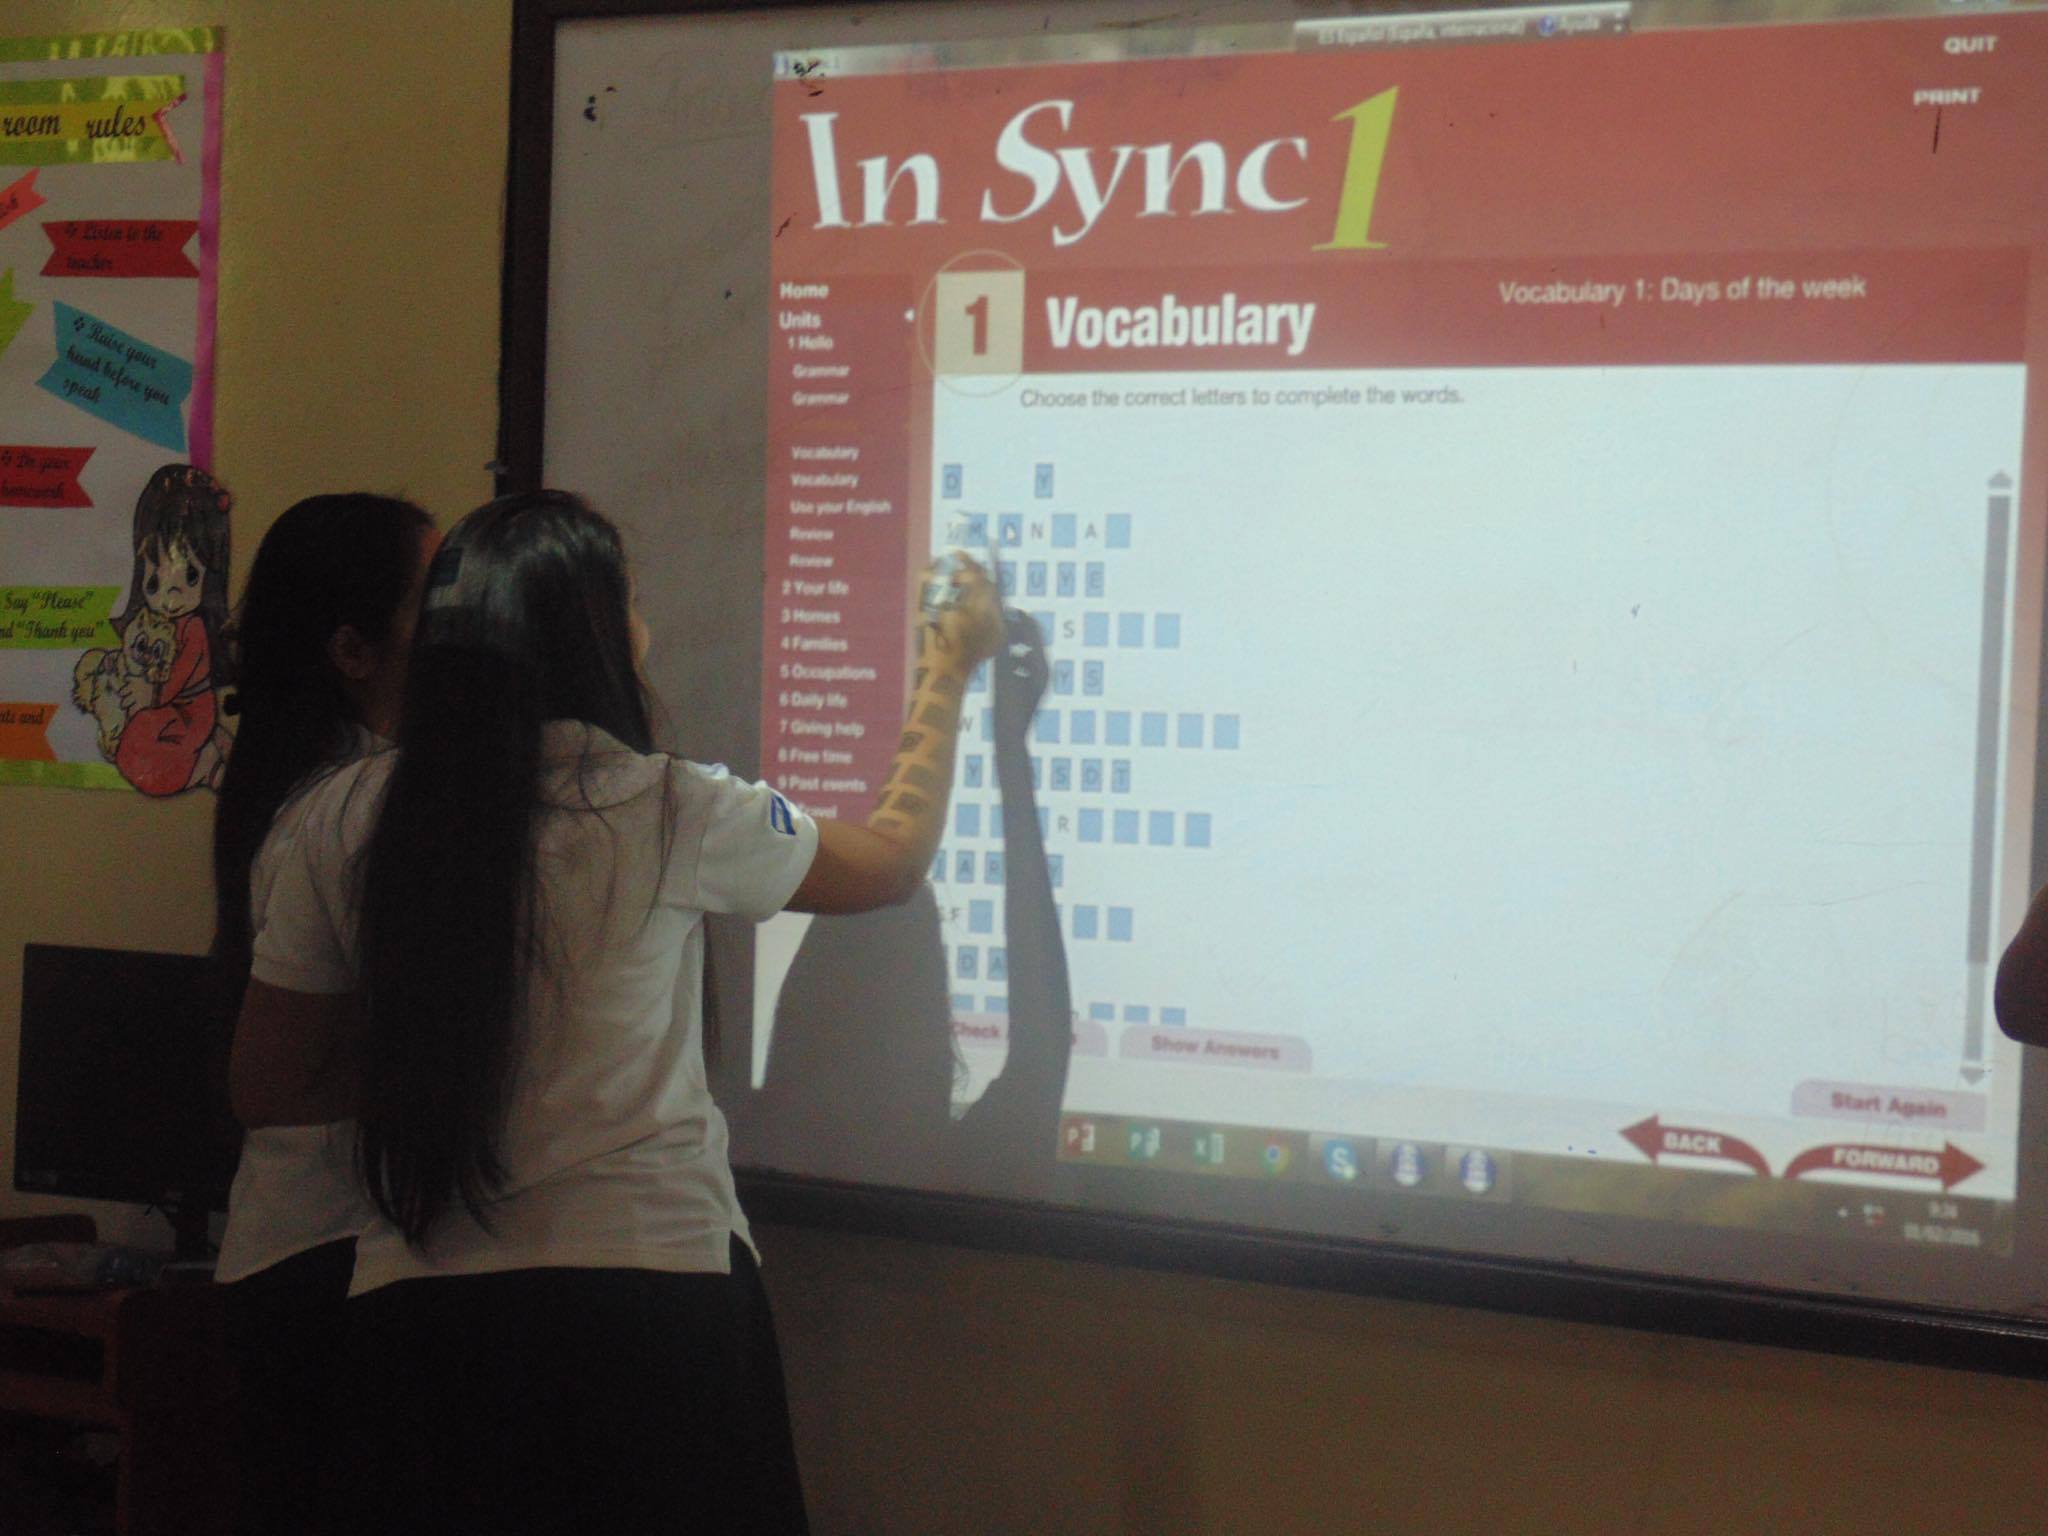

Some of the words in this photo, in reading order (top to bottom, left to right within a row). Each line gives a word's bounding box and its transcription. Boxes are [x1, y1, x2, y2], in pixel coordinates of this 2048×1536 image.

[1943, 35, 1998, 55] QUIT
[1913, 87, 1981, 106] PRINT
[86, 105, 147, 139] rules
[800, 112, 947, 230] In
[981, 100, 1309, 248] Sync
[1312, 85, 1399, 253] 1
[780, 283, 829, 299] Home
[1500, 281, 1626, 307] Vocabulary
[1636, 279, 1653, 301] 1:
[1661, 277, 1720, 305] Days
[1726, 276, 1750, 300] of
[1757, 275, 1794, 299] the
[1803, 275, 1866, 299] week
[779, 311, 821, 330] Units
[965, 295, 988, 356] 1
[1046, 294, 1316, 356] Vocabulary
[1020, 387, 1087, 407] Choose
[1092, 388, 1120, 406] the
[1124, 388, 1186, 406] correct
[1192, 387, 1246, 406] letters
[1252, 388, 1270, 405] to
[1275, 386, 1361, 408] complete
[1366, 386, 1395, 404] the
[1401, 386, 1464, 404] words.
[791, 446, 860, 460] Vocabulary
[791, 473, 859, 487] Vocabulary
[847, 499, 892, 515] English
[793, 610, 841, 623] Homes
[792, 664, 877, 681] Occupations
[1151, 1035, 1199, 1054] Show
[1205, 1040, 1279, 1060] Answers
[1832, 1092, 1881, 1113] Start
[1888, 1097, 1947, 1120] Again
[1664, 1131, 1721, 1154] BACK
[1833, 1148, 1940, 1175] FORWARD
